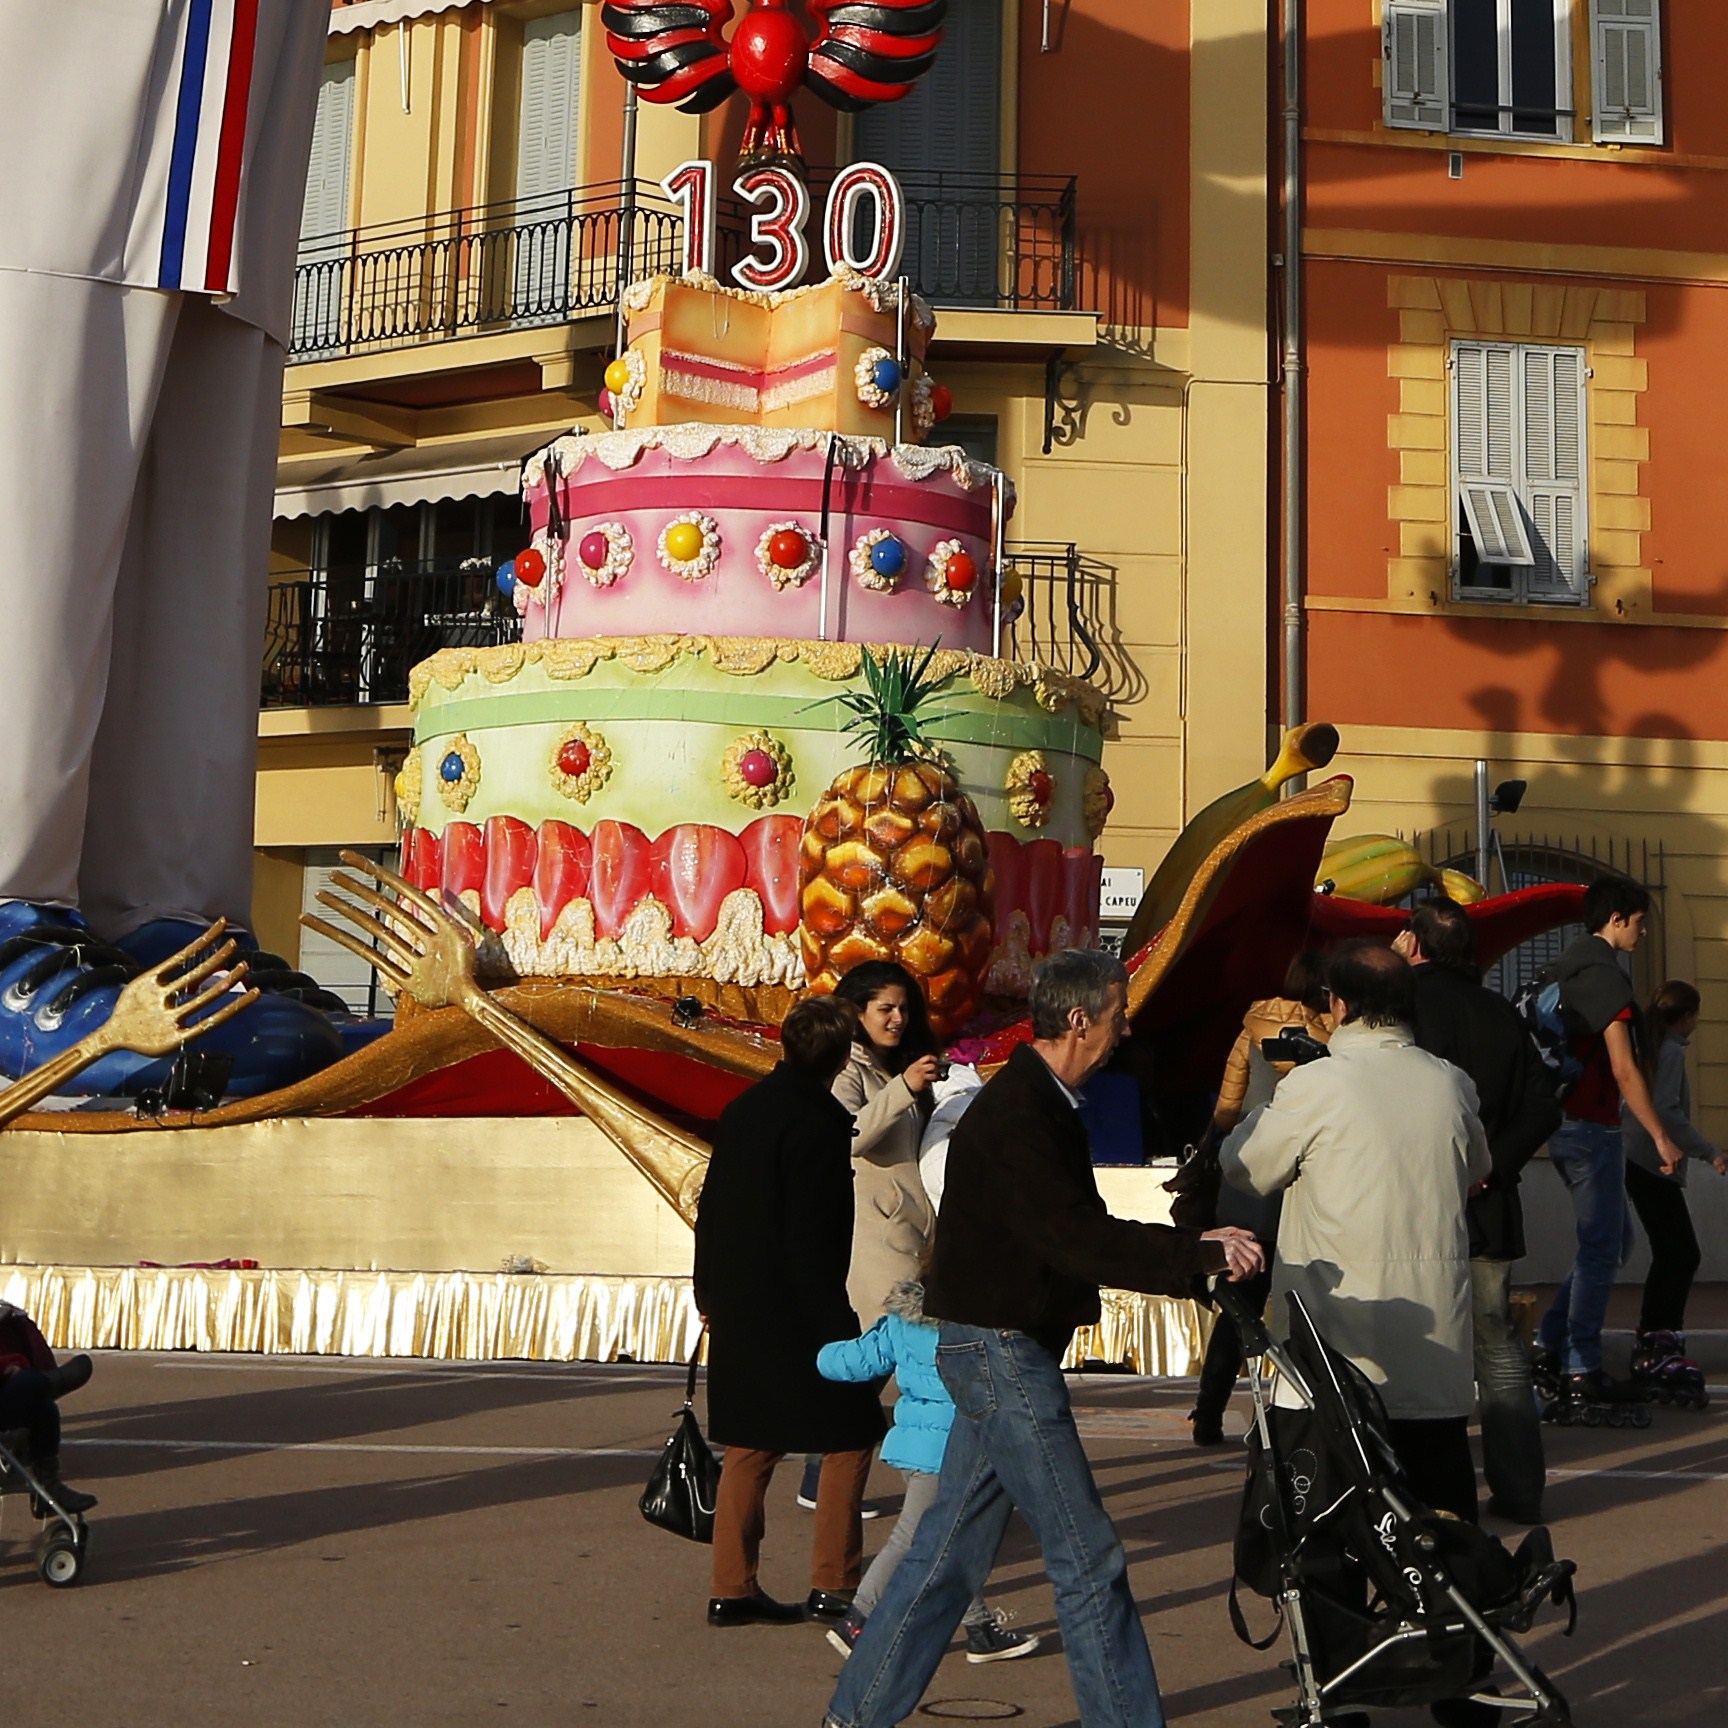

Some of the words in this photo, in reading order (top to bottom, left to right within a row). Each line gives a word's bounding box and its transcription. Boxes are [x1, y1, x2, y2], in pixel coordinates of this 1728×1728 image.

[660, 160, 905, 292] 130
[1101, 877, 1111, 887] AI
[1105, 896, 1137, 907] CAPEU
